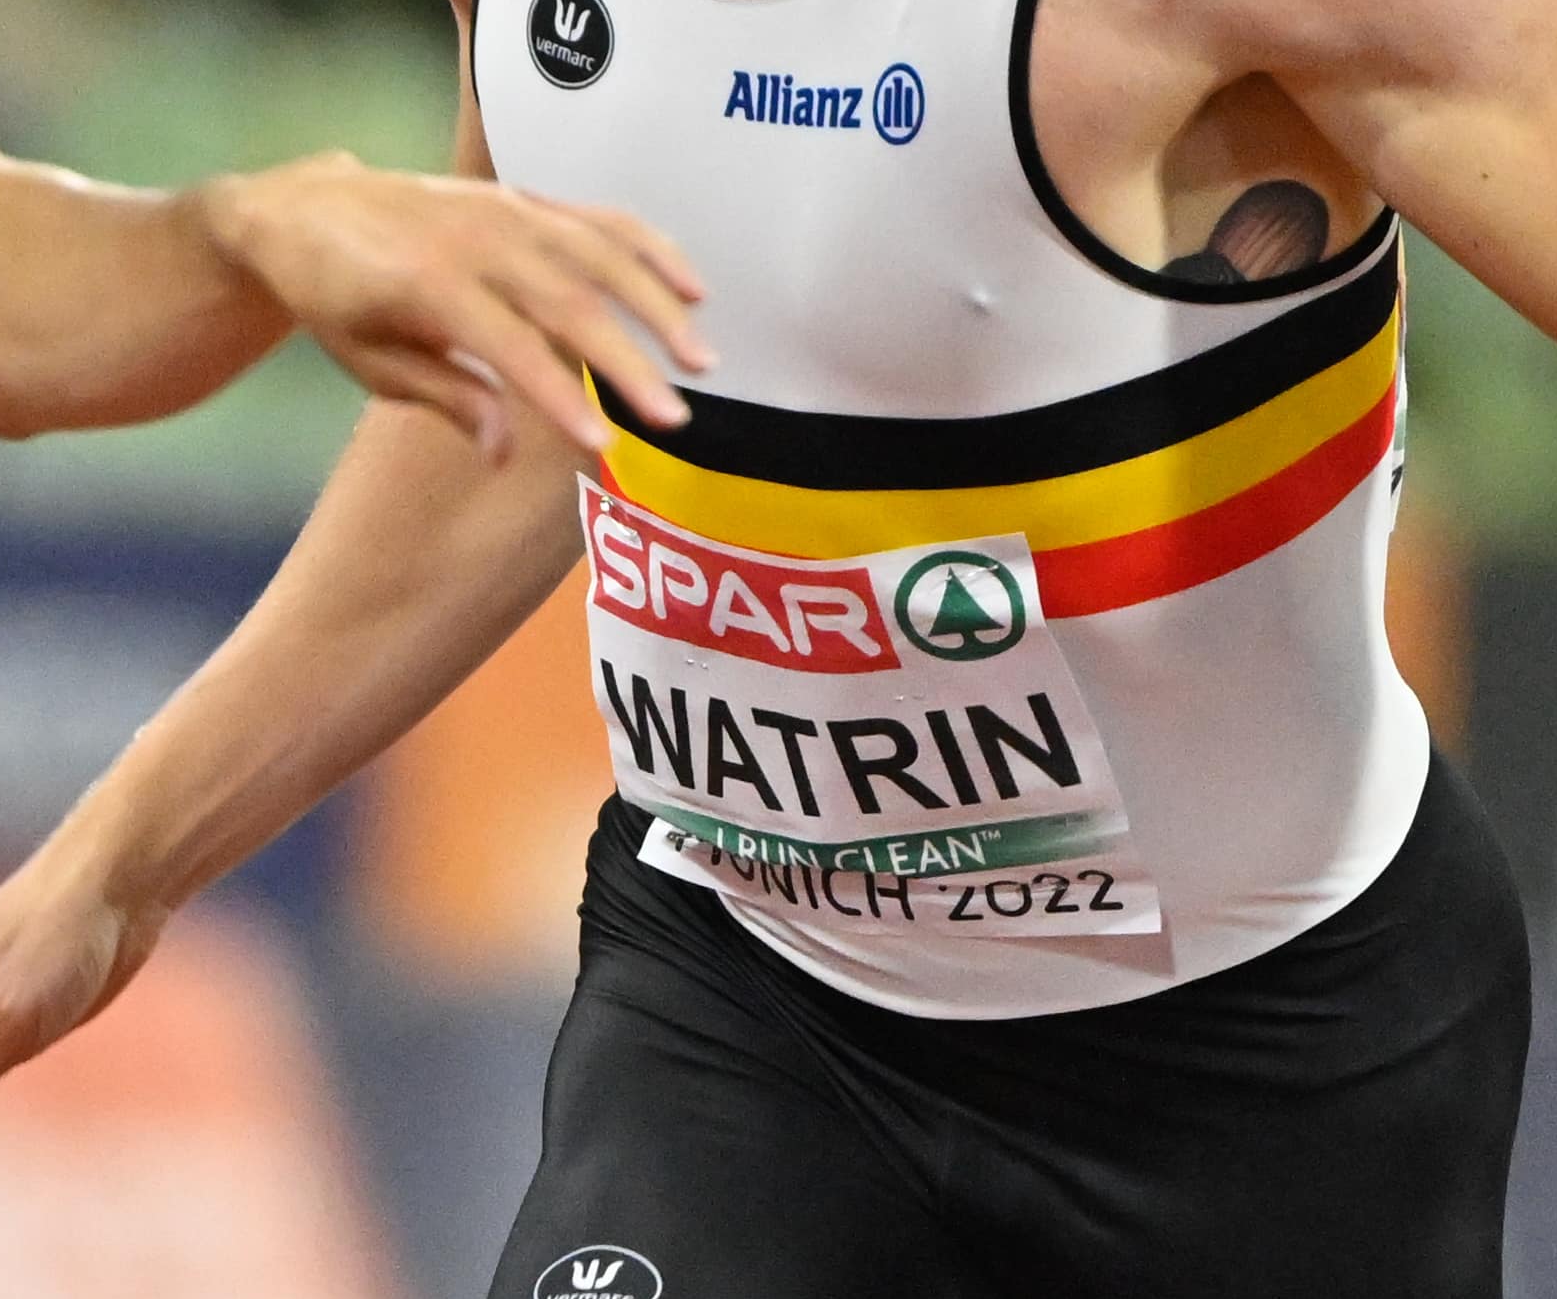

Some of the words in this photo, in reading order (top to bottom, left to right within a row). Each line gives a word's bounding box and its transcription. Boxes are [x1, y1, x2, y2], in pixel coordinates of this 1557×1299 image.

[535, 36, 596, 71] vermarc
[724, 71, 864, 129] Allianz
[591, 512, 882, 658] SPAR
[599, 659, 1082, 817] WATRIN
